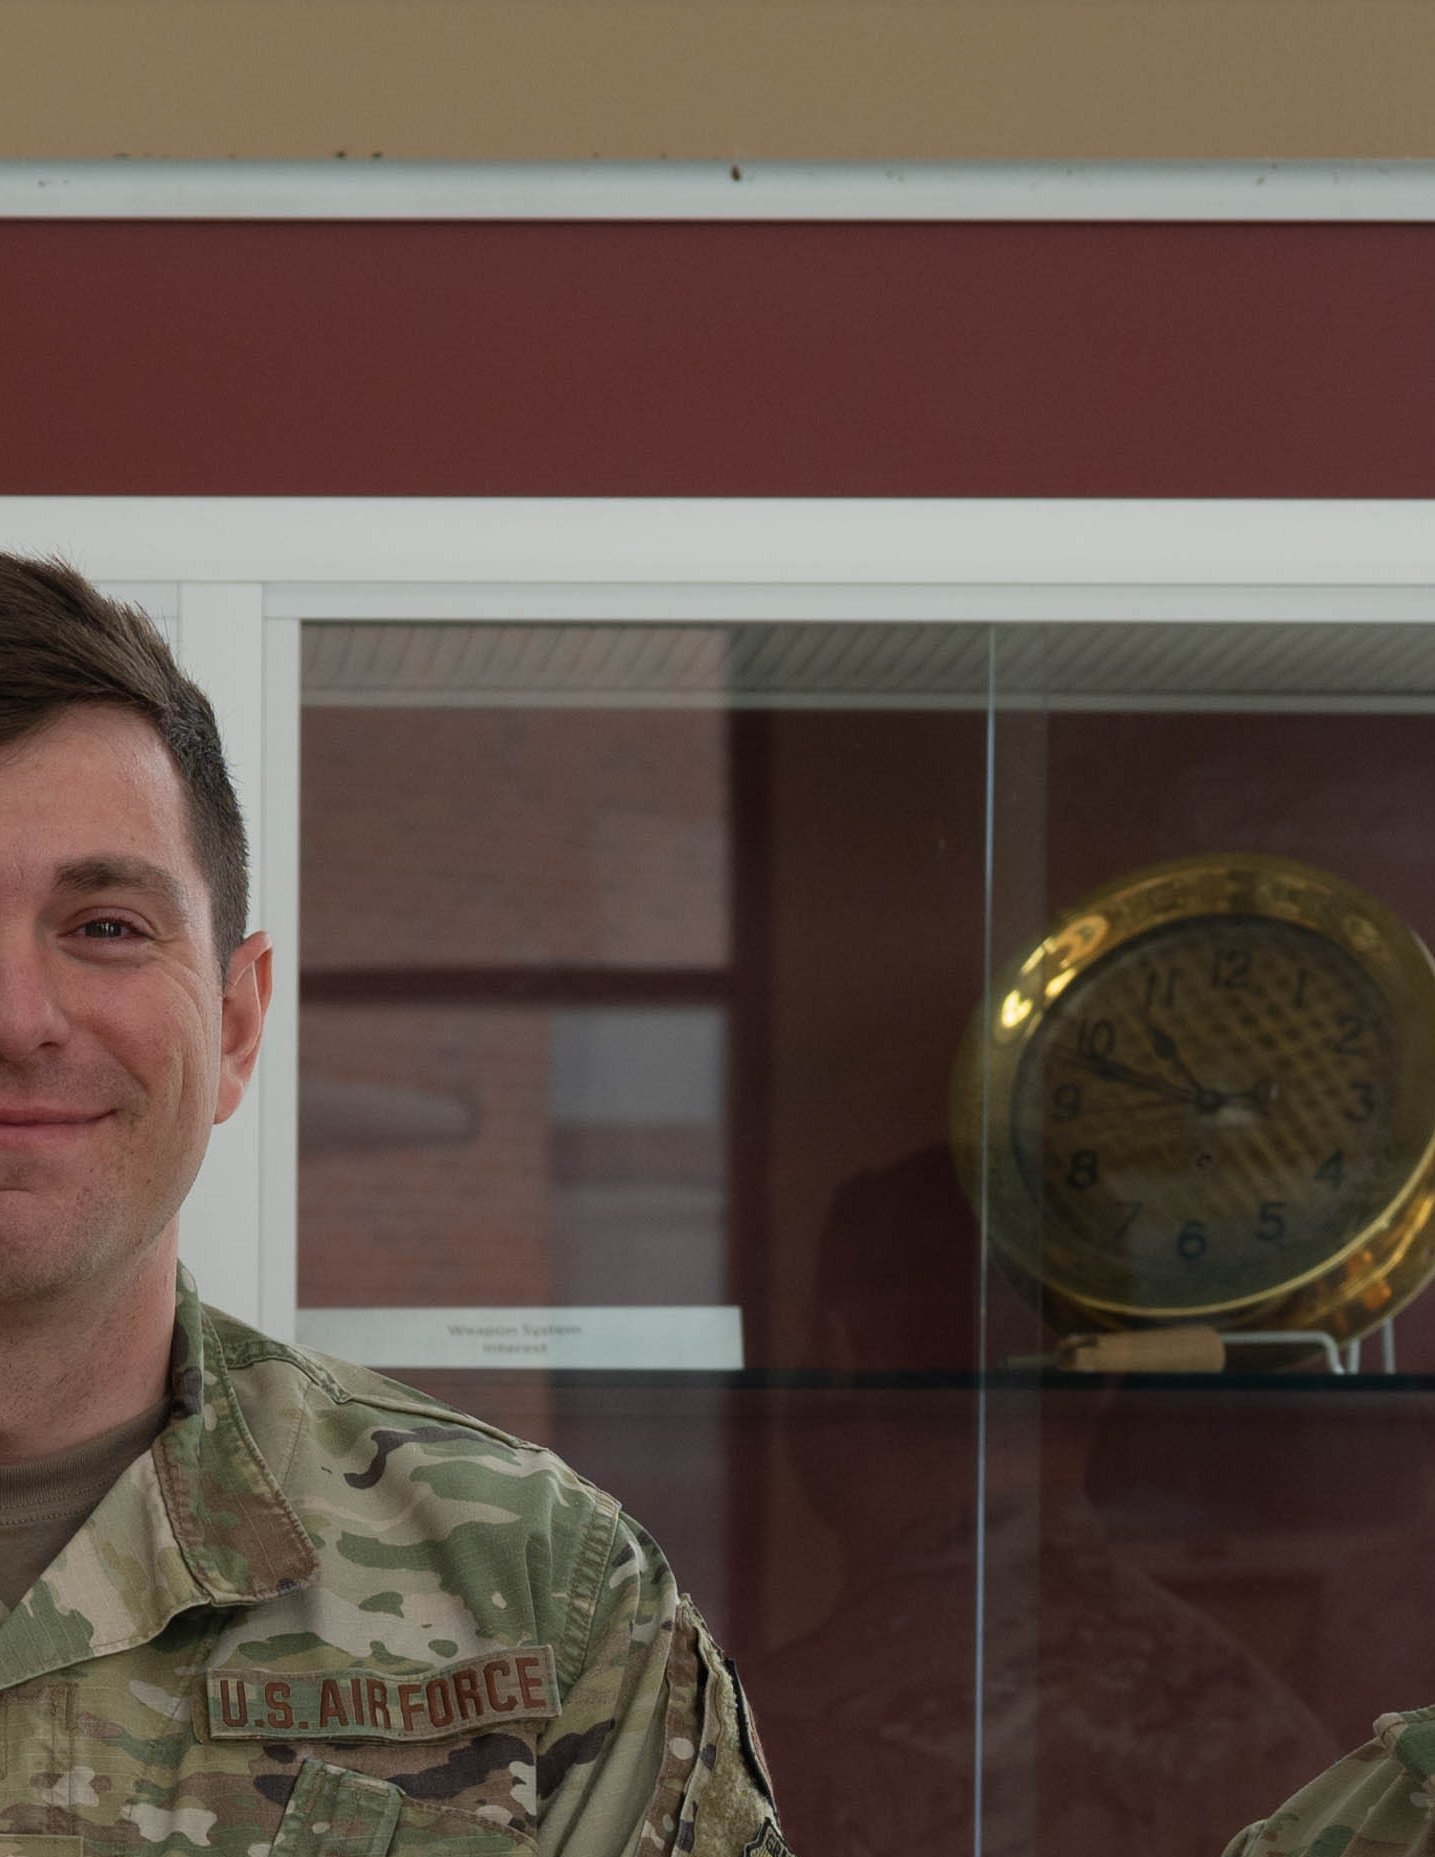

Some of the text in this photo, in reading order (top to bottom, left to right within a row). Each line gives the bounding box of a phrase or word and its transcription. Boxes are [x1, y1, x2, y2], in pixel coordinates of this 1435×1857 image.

[1145, 966, 1181, 1007] 11
[1210, 952, 1252, 991] 12
[1335, 1013, 1365, 1053] 2
[1052, 1083, 1081, 1122] 9
[1346, 1080, 1376, 1122] 3
[1067, 1149, 1099, 1190] 8
[1314, 1150, 1345, 1190] 4
[1177, 1218, 1207, 1258] 6
[1255, 1201, 1286, 1243] 5
[219, 1656, 548, 1732] U.S. AIR FORCE
